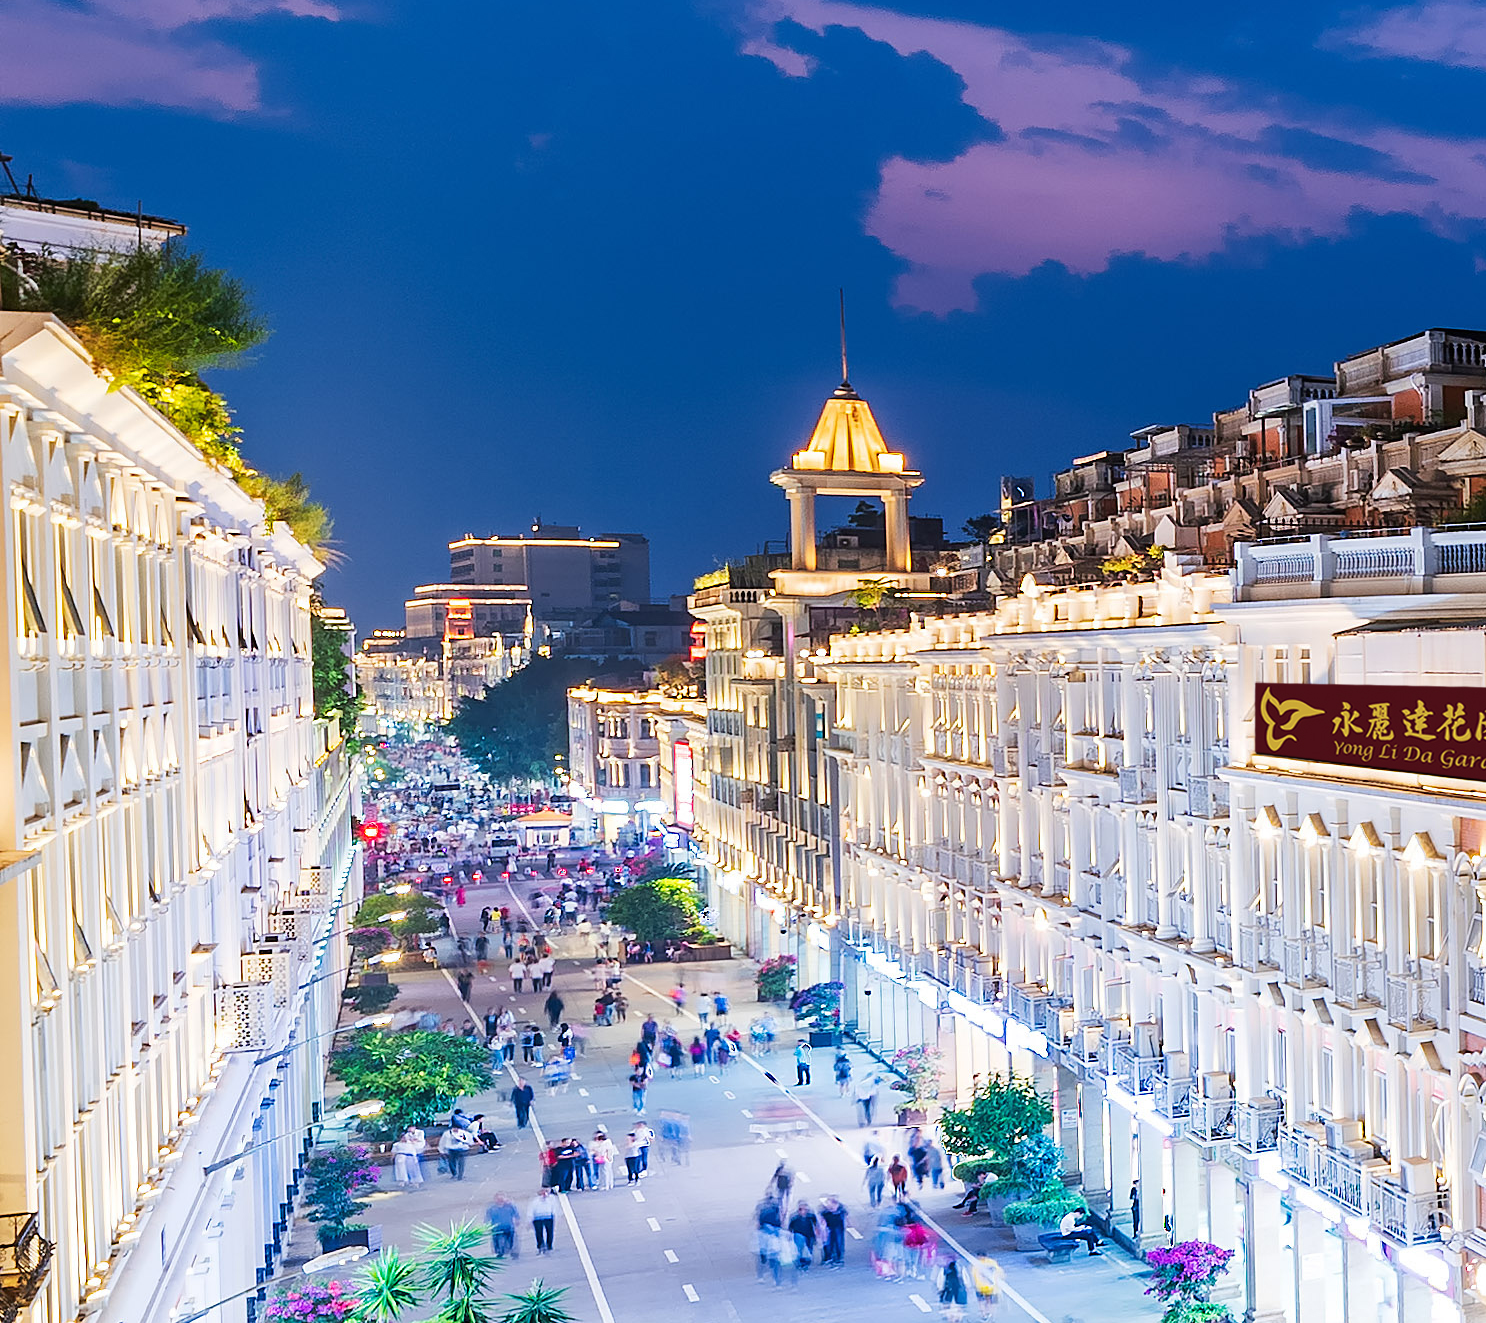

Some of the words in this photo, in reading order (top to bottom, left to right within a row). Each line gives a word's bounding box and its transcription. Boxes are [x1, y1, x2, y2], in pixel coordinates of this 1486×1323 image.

[1333, 740, 1374, 763] Yong
[1378, 742, 1398, 759] Li
[1403, 745, 1434, 764] Da
